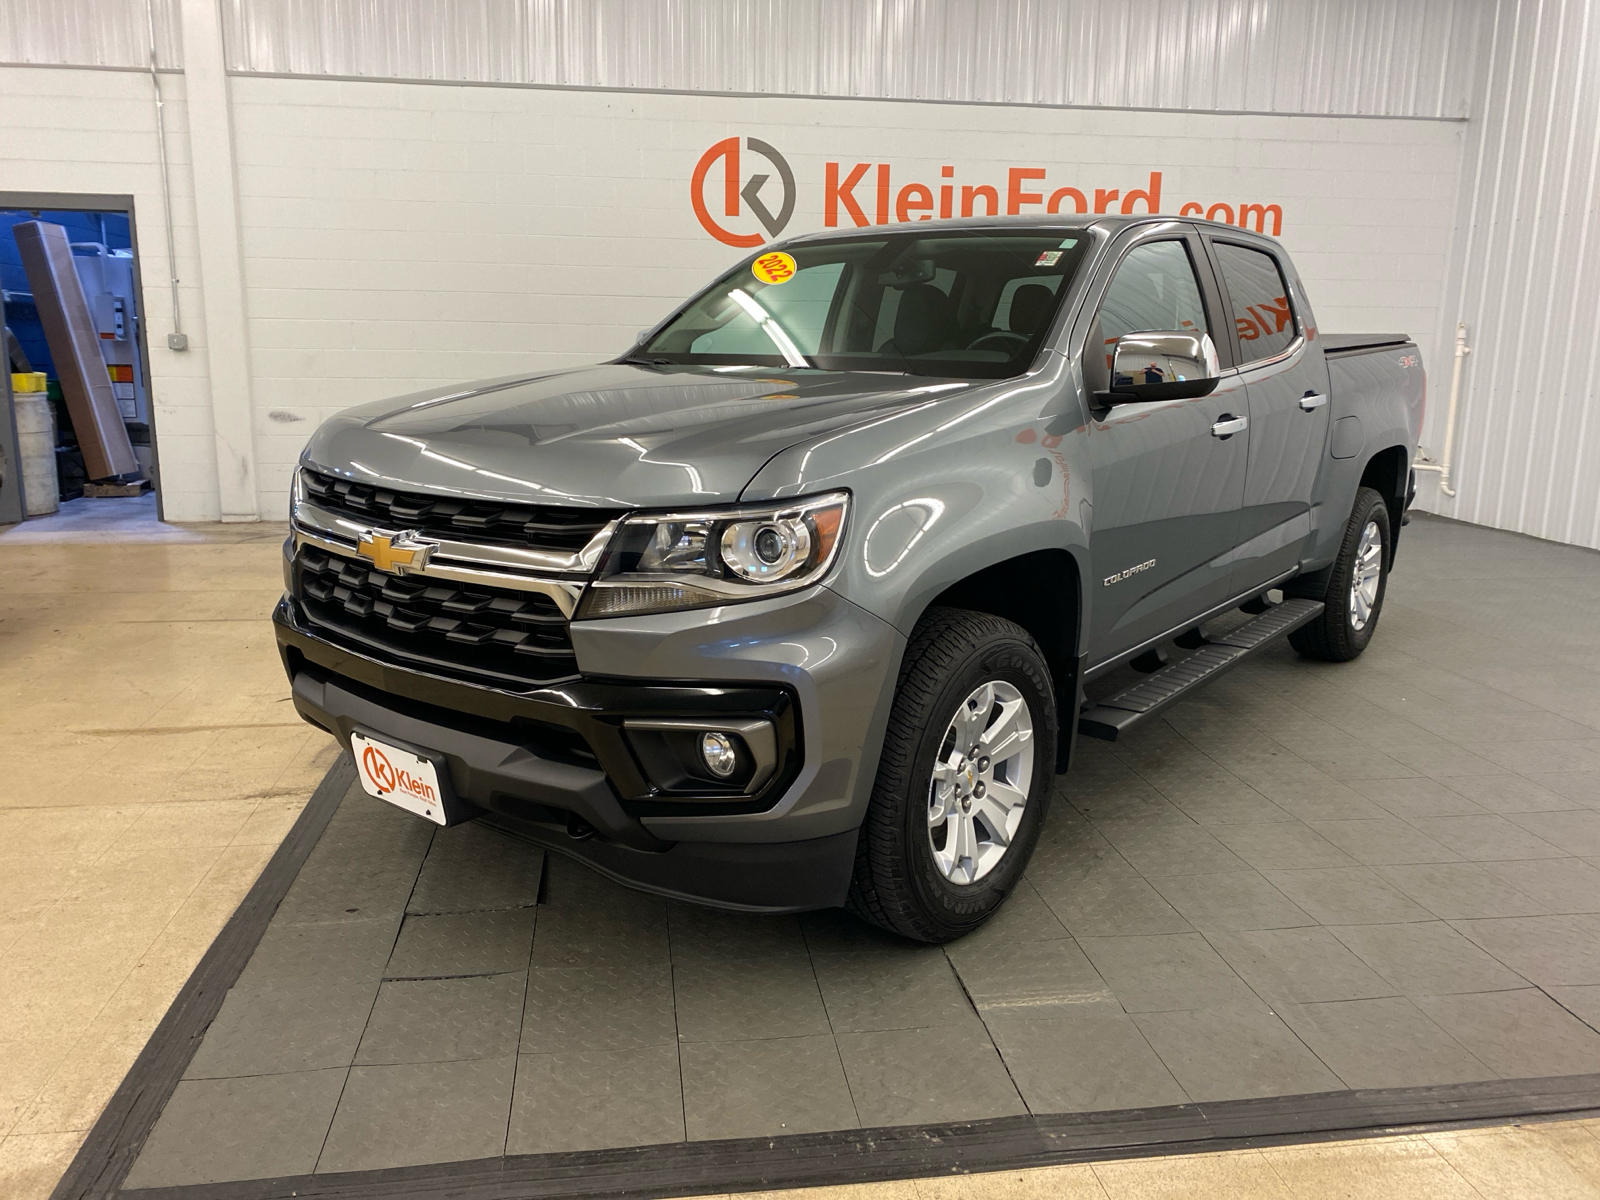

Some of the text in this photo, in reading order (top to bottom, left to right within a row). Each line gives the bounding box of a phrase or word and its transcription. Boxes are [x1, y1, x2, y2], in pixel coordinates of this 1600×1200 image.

[824, 161, 1283, 237] KleinFordcom
[757, 254, 793, 282] 2022
[1103, 558, 1156, 587] COLORADO
[394, 766, 436, 802] Klein
